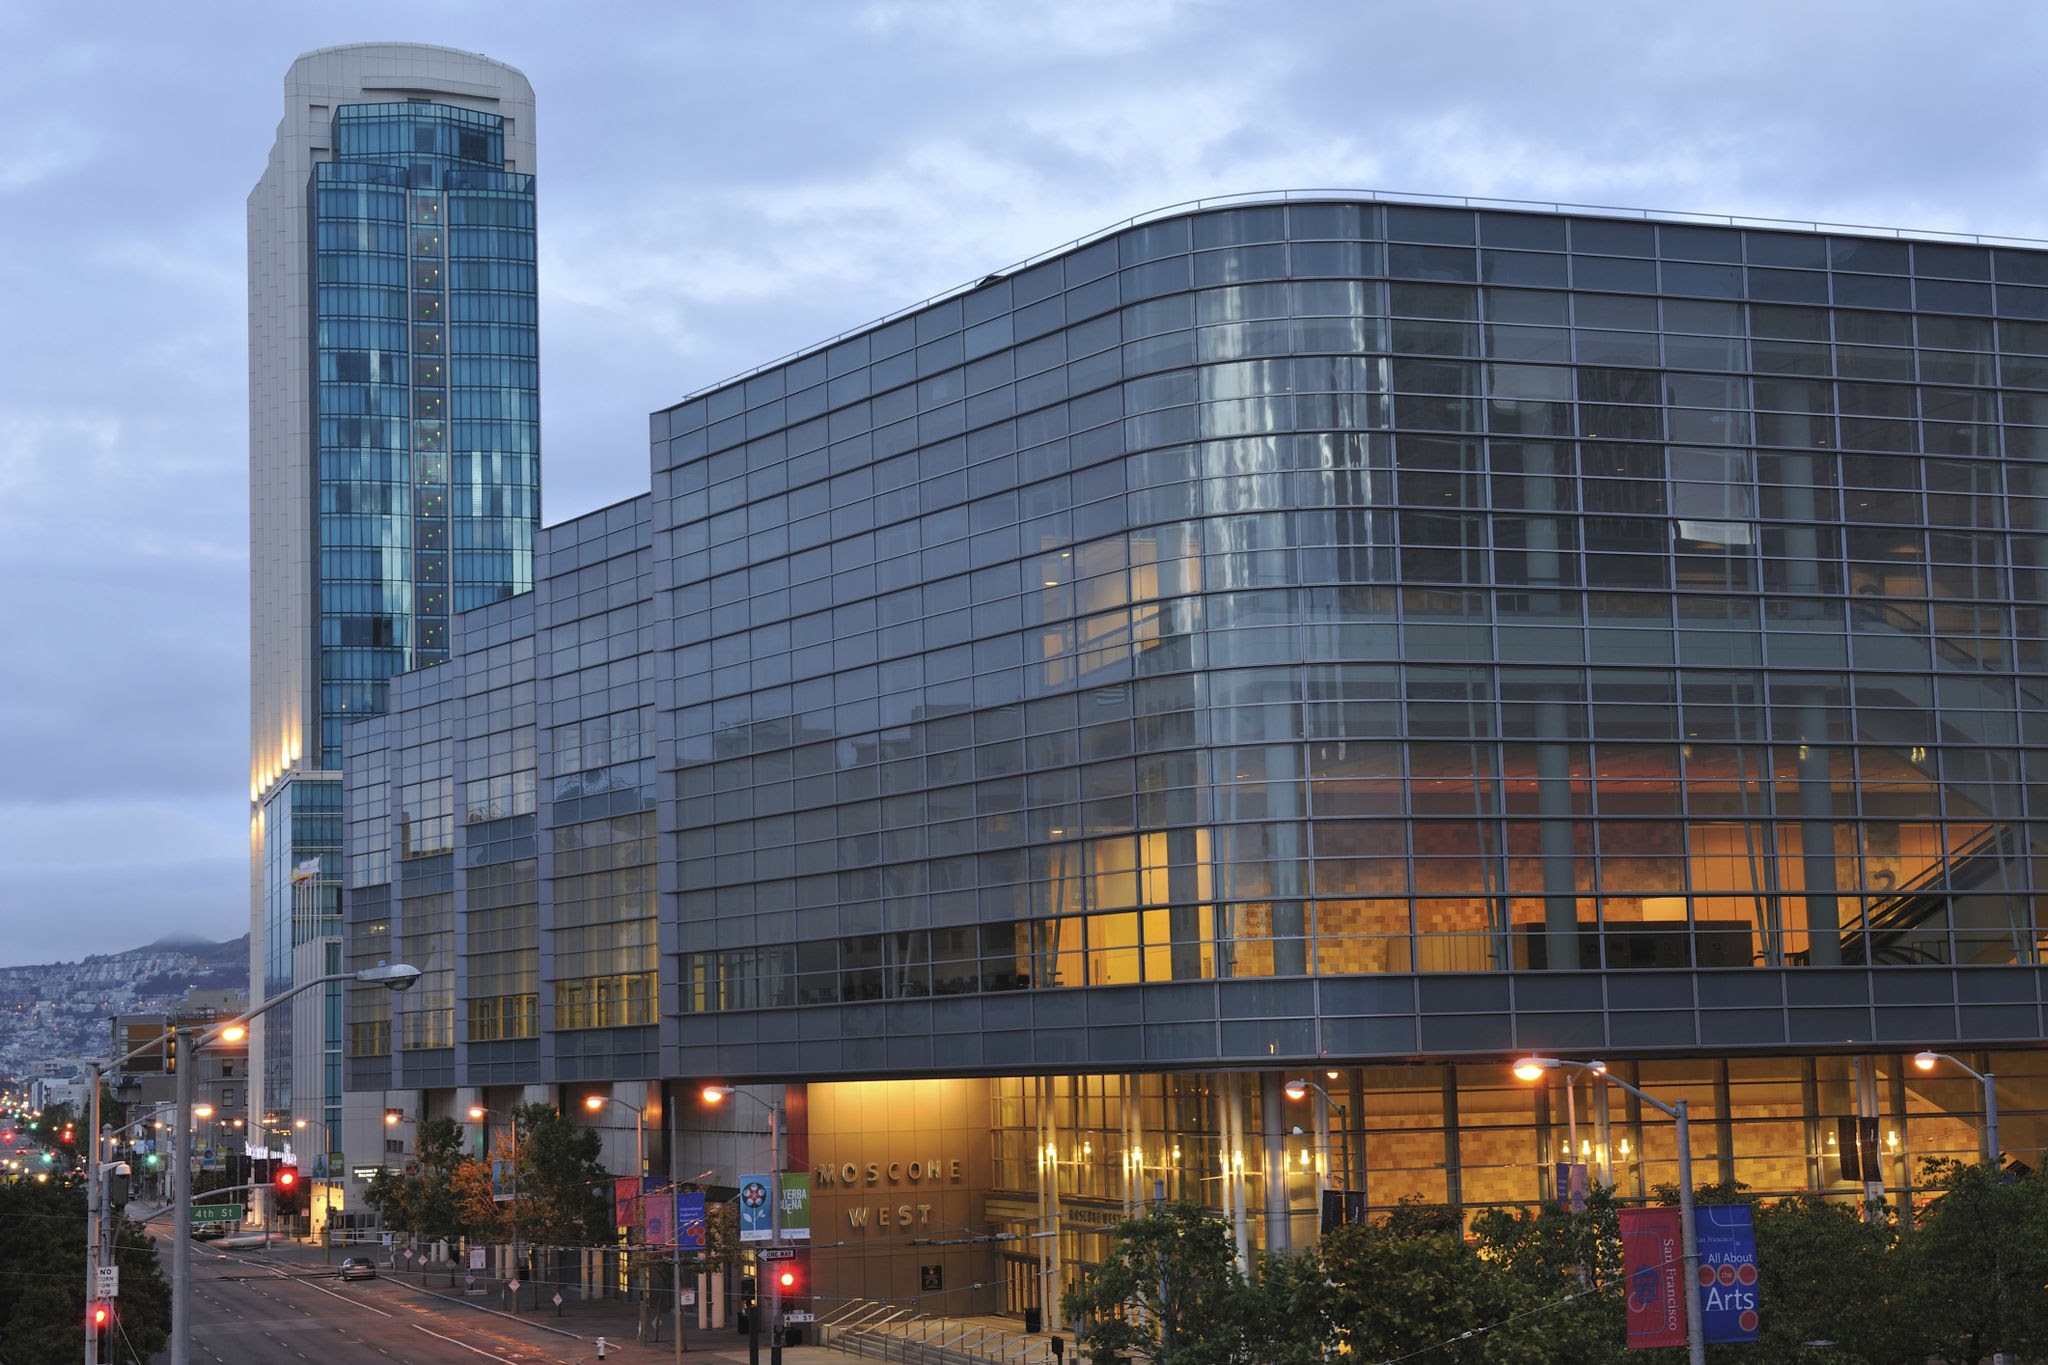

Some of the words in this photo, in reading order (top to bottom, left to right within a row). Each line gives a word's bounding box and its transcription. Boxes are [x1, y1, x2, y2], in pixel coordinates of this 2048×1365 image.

[817, 1159, 961, 1184] MOSCONE
[782, 1188, 807, 1199] YERBA
[195, 1209, 214, 1218] 4th
[221, 1208, 233, 1217] St
[848, 1204, 932, 1228] WEST
[1663, 1238, 1675, 1264] San
[1707, 1252, 1721, 1264] All
[1723, 1251, 1753, 1263] About
[1665, 1268, 1679, 1331] Francisco
[1705, 1286, 1754, 1311] Arts
